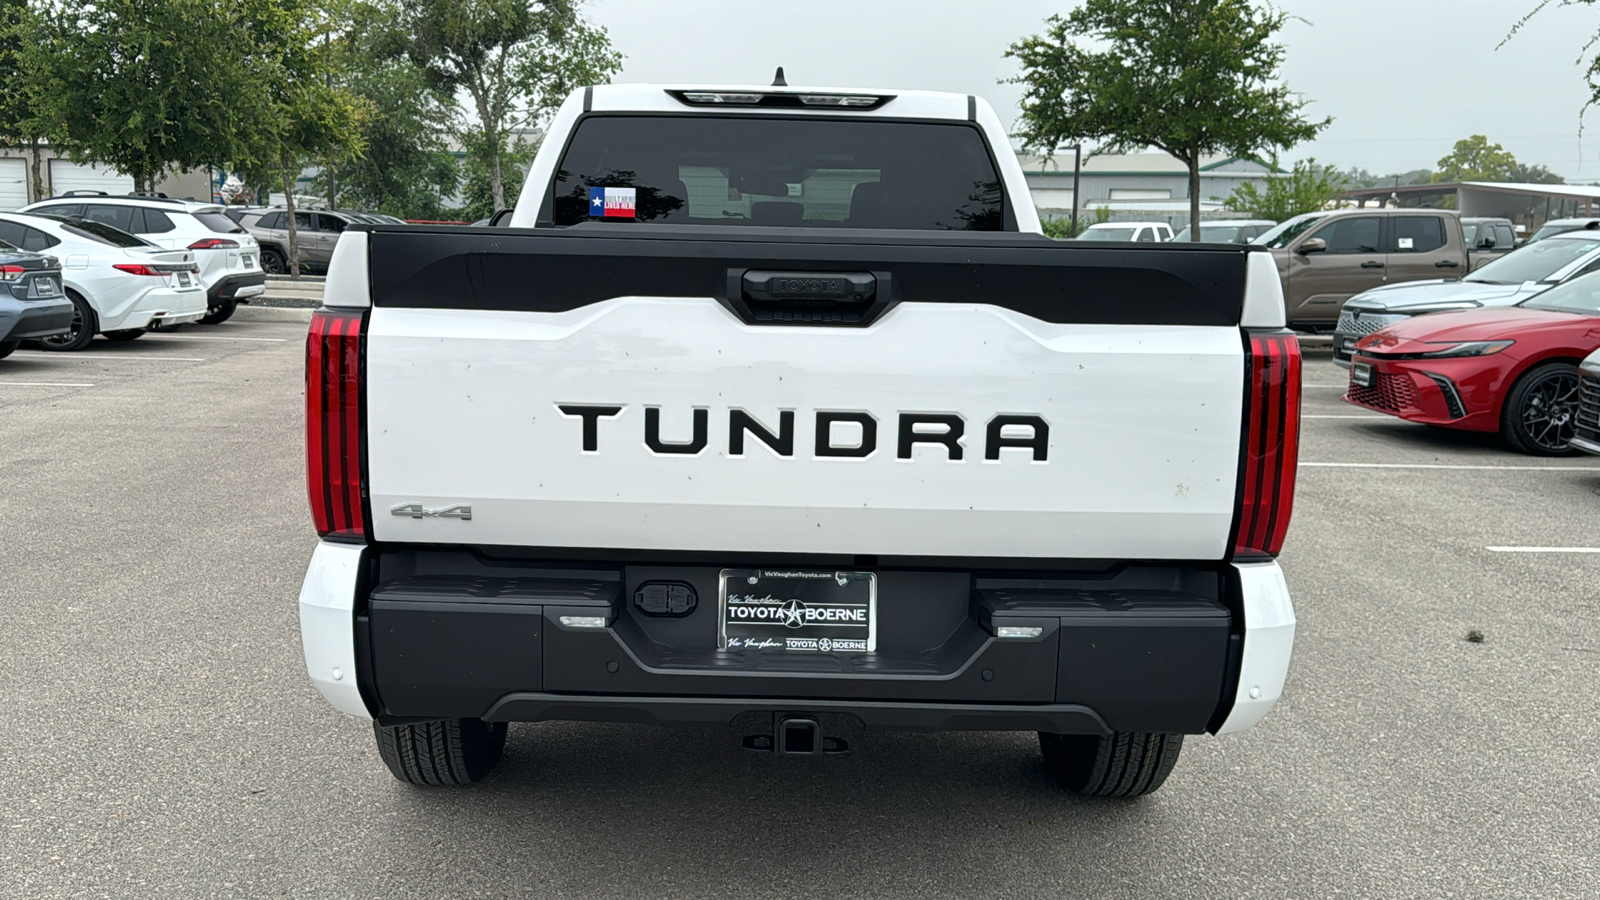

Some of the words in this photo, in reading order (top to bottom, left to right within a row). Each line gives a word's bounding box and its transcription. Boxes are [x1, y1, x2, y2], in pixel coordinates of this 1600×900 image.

[779, 279, 839, 293] TOYOTA
[555, 403, 1051, 463] TUNDRA
[764, 571, 832, 579] VicVaughanToyota.com
[728, 606, 785, 618] TOYOTA
[805, 608, 867, 621] BOERNE
[786, 640, 818, 648] TOYOTA
[832, 641, 867, 650] BOERNE
